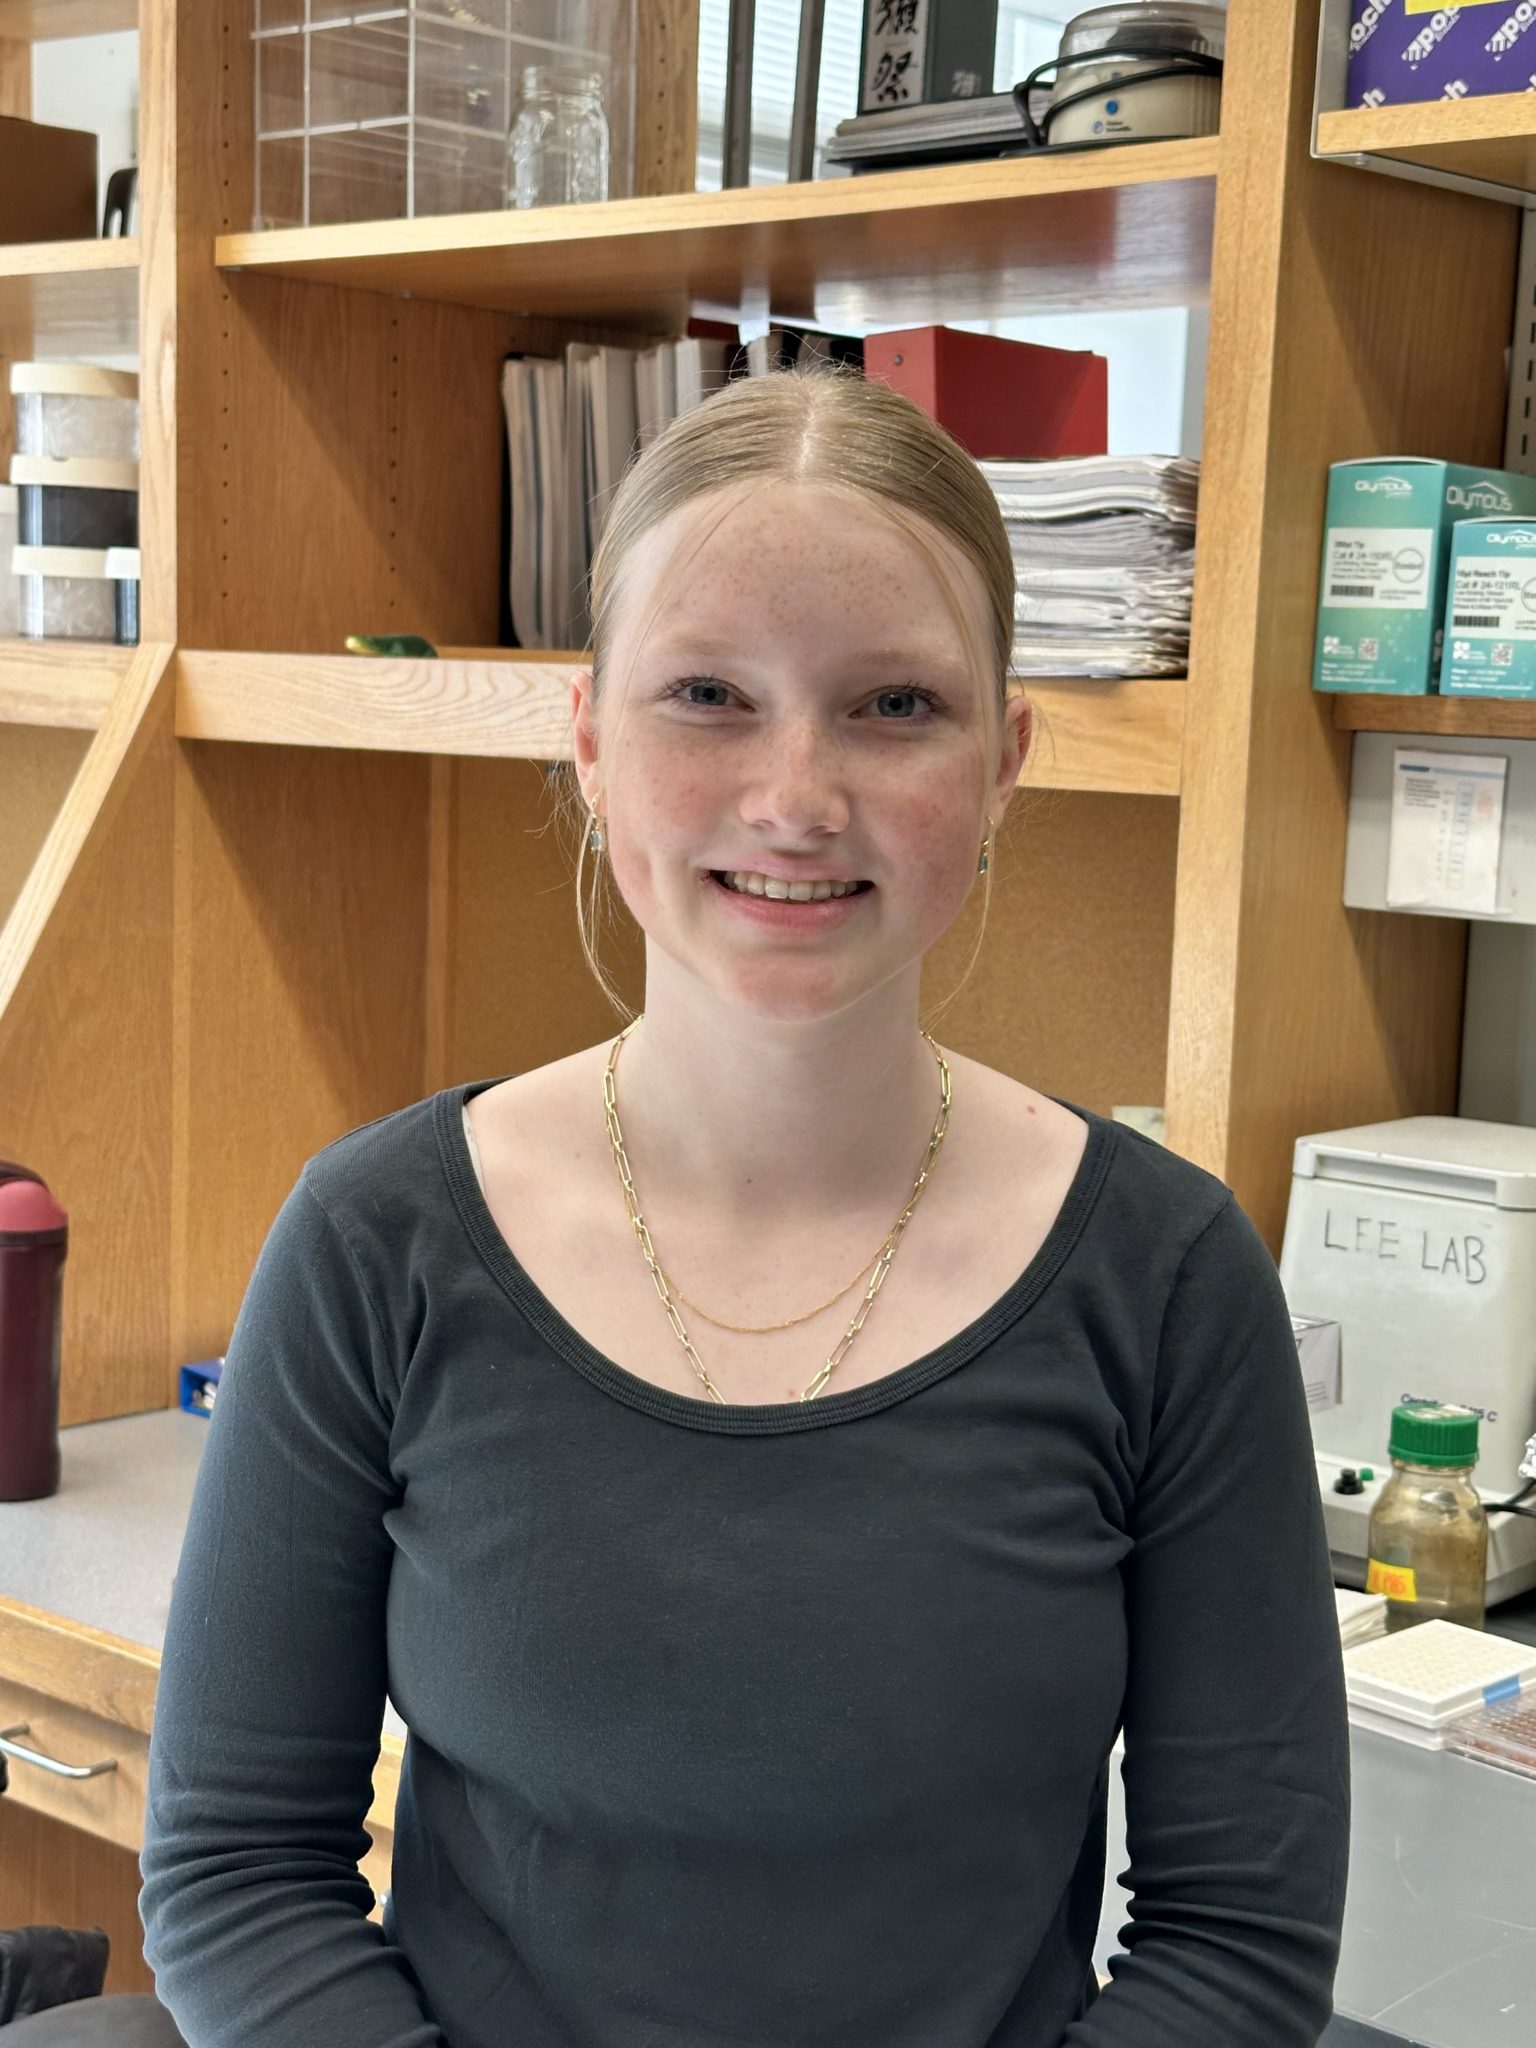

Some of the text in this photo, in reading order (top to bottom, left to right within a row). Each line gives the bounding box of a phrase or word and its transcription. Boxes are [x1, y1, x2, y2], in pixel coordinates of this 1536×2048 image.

[1446, 485, 1513, 511] Olympus
[1324, 1209, 1487, 1285] LEE LAB
